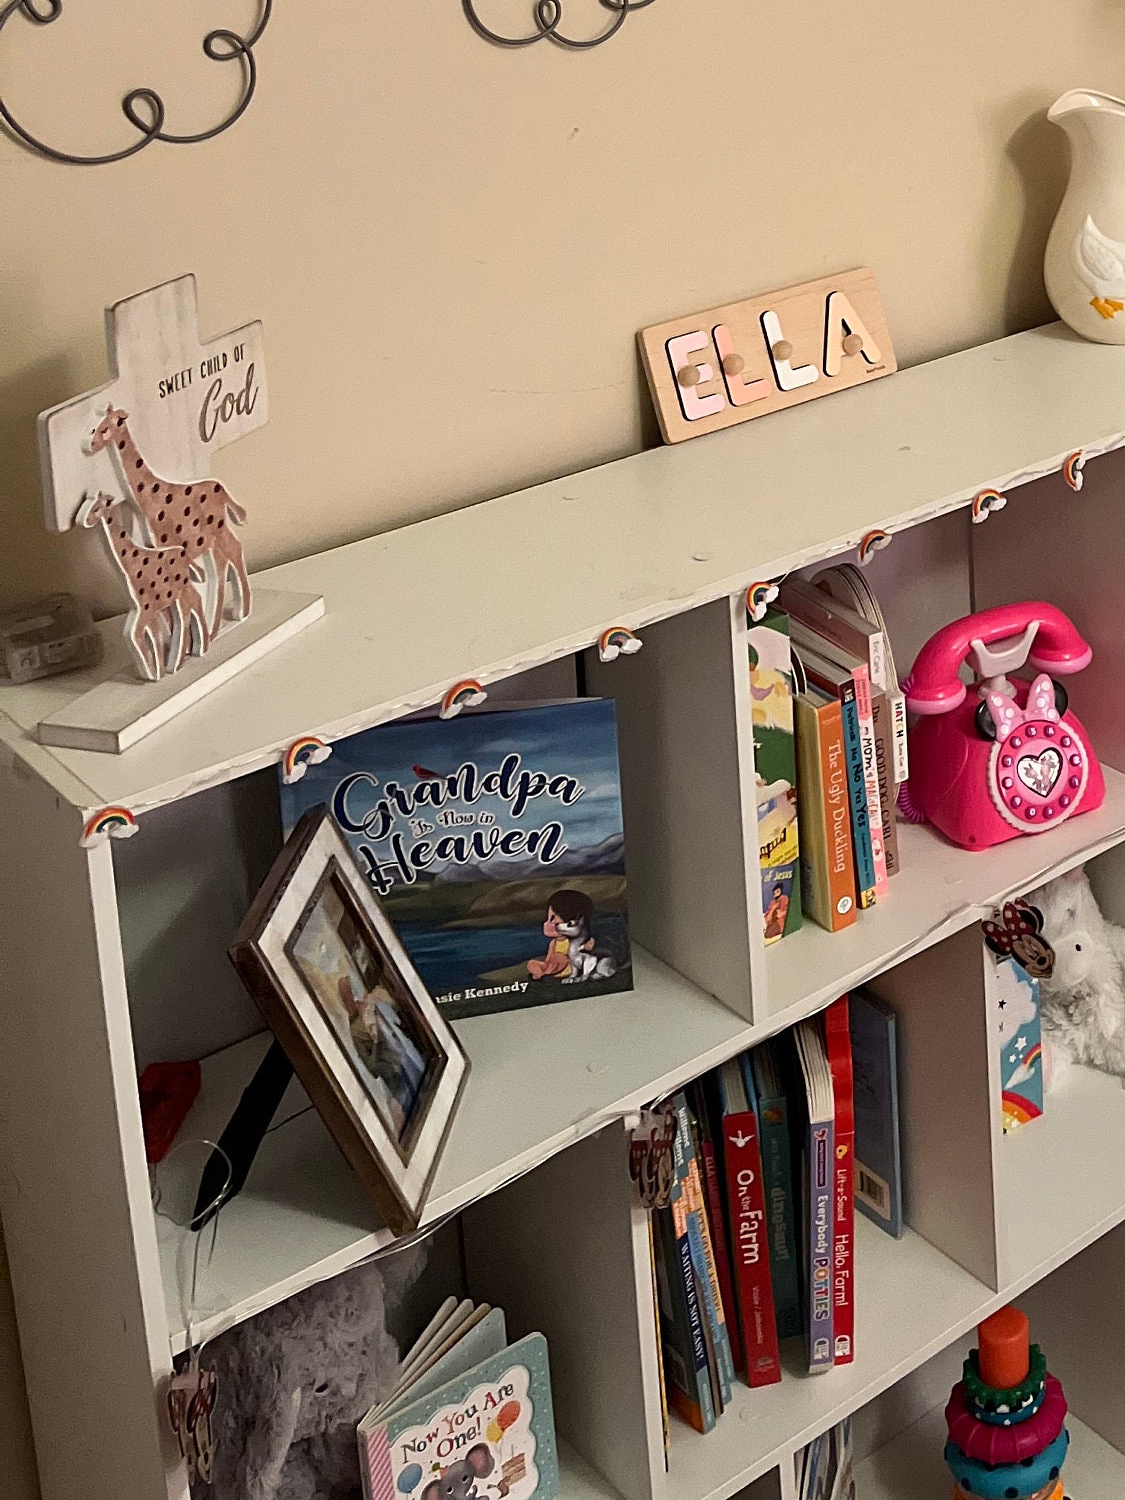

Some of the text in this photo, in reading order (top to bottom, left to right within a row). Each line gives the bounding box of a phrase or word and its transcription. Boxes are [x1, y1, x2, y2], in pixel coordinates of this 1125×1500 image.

[158, 343, 247, 399] SWEET CHILD OF
[665, 291, 882, 422] ELLA
[198, 362, 260, 443] God
[894, 702, 905, 738] HATCH
[334, 753, 586, 841] Grandpa
[411, 810, 496, 839] Is Now in
[828, 739, 849, 873] The Ugly Duckling
[357, 821, 569, 896] Heaven
[464, 981, 529, 1000] Kennedy
[736, 1169, 755, 1198] On
[741, 1196, 752, 1211] the
[739, 1210, 763, 1265] Farm
[815, 1195, 829, 1254] Everybody
[835, 1169, 850, 1306] Lift-a-Sound Hello, Farm!
[681, 1243, 692, 1293] WAITING
[814, 1256, 830, 1321] POTTIES
[688, 1291, 696, 1305] IS
[689, 1304, 700, 1327] NOT
[400, 1383, 514, 1464] Now You Are
[436, 1416, 482, 1458] One!
